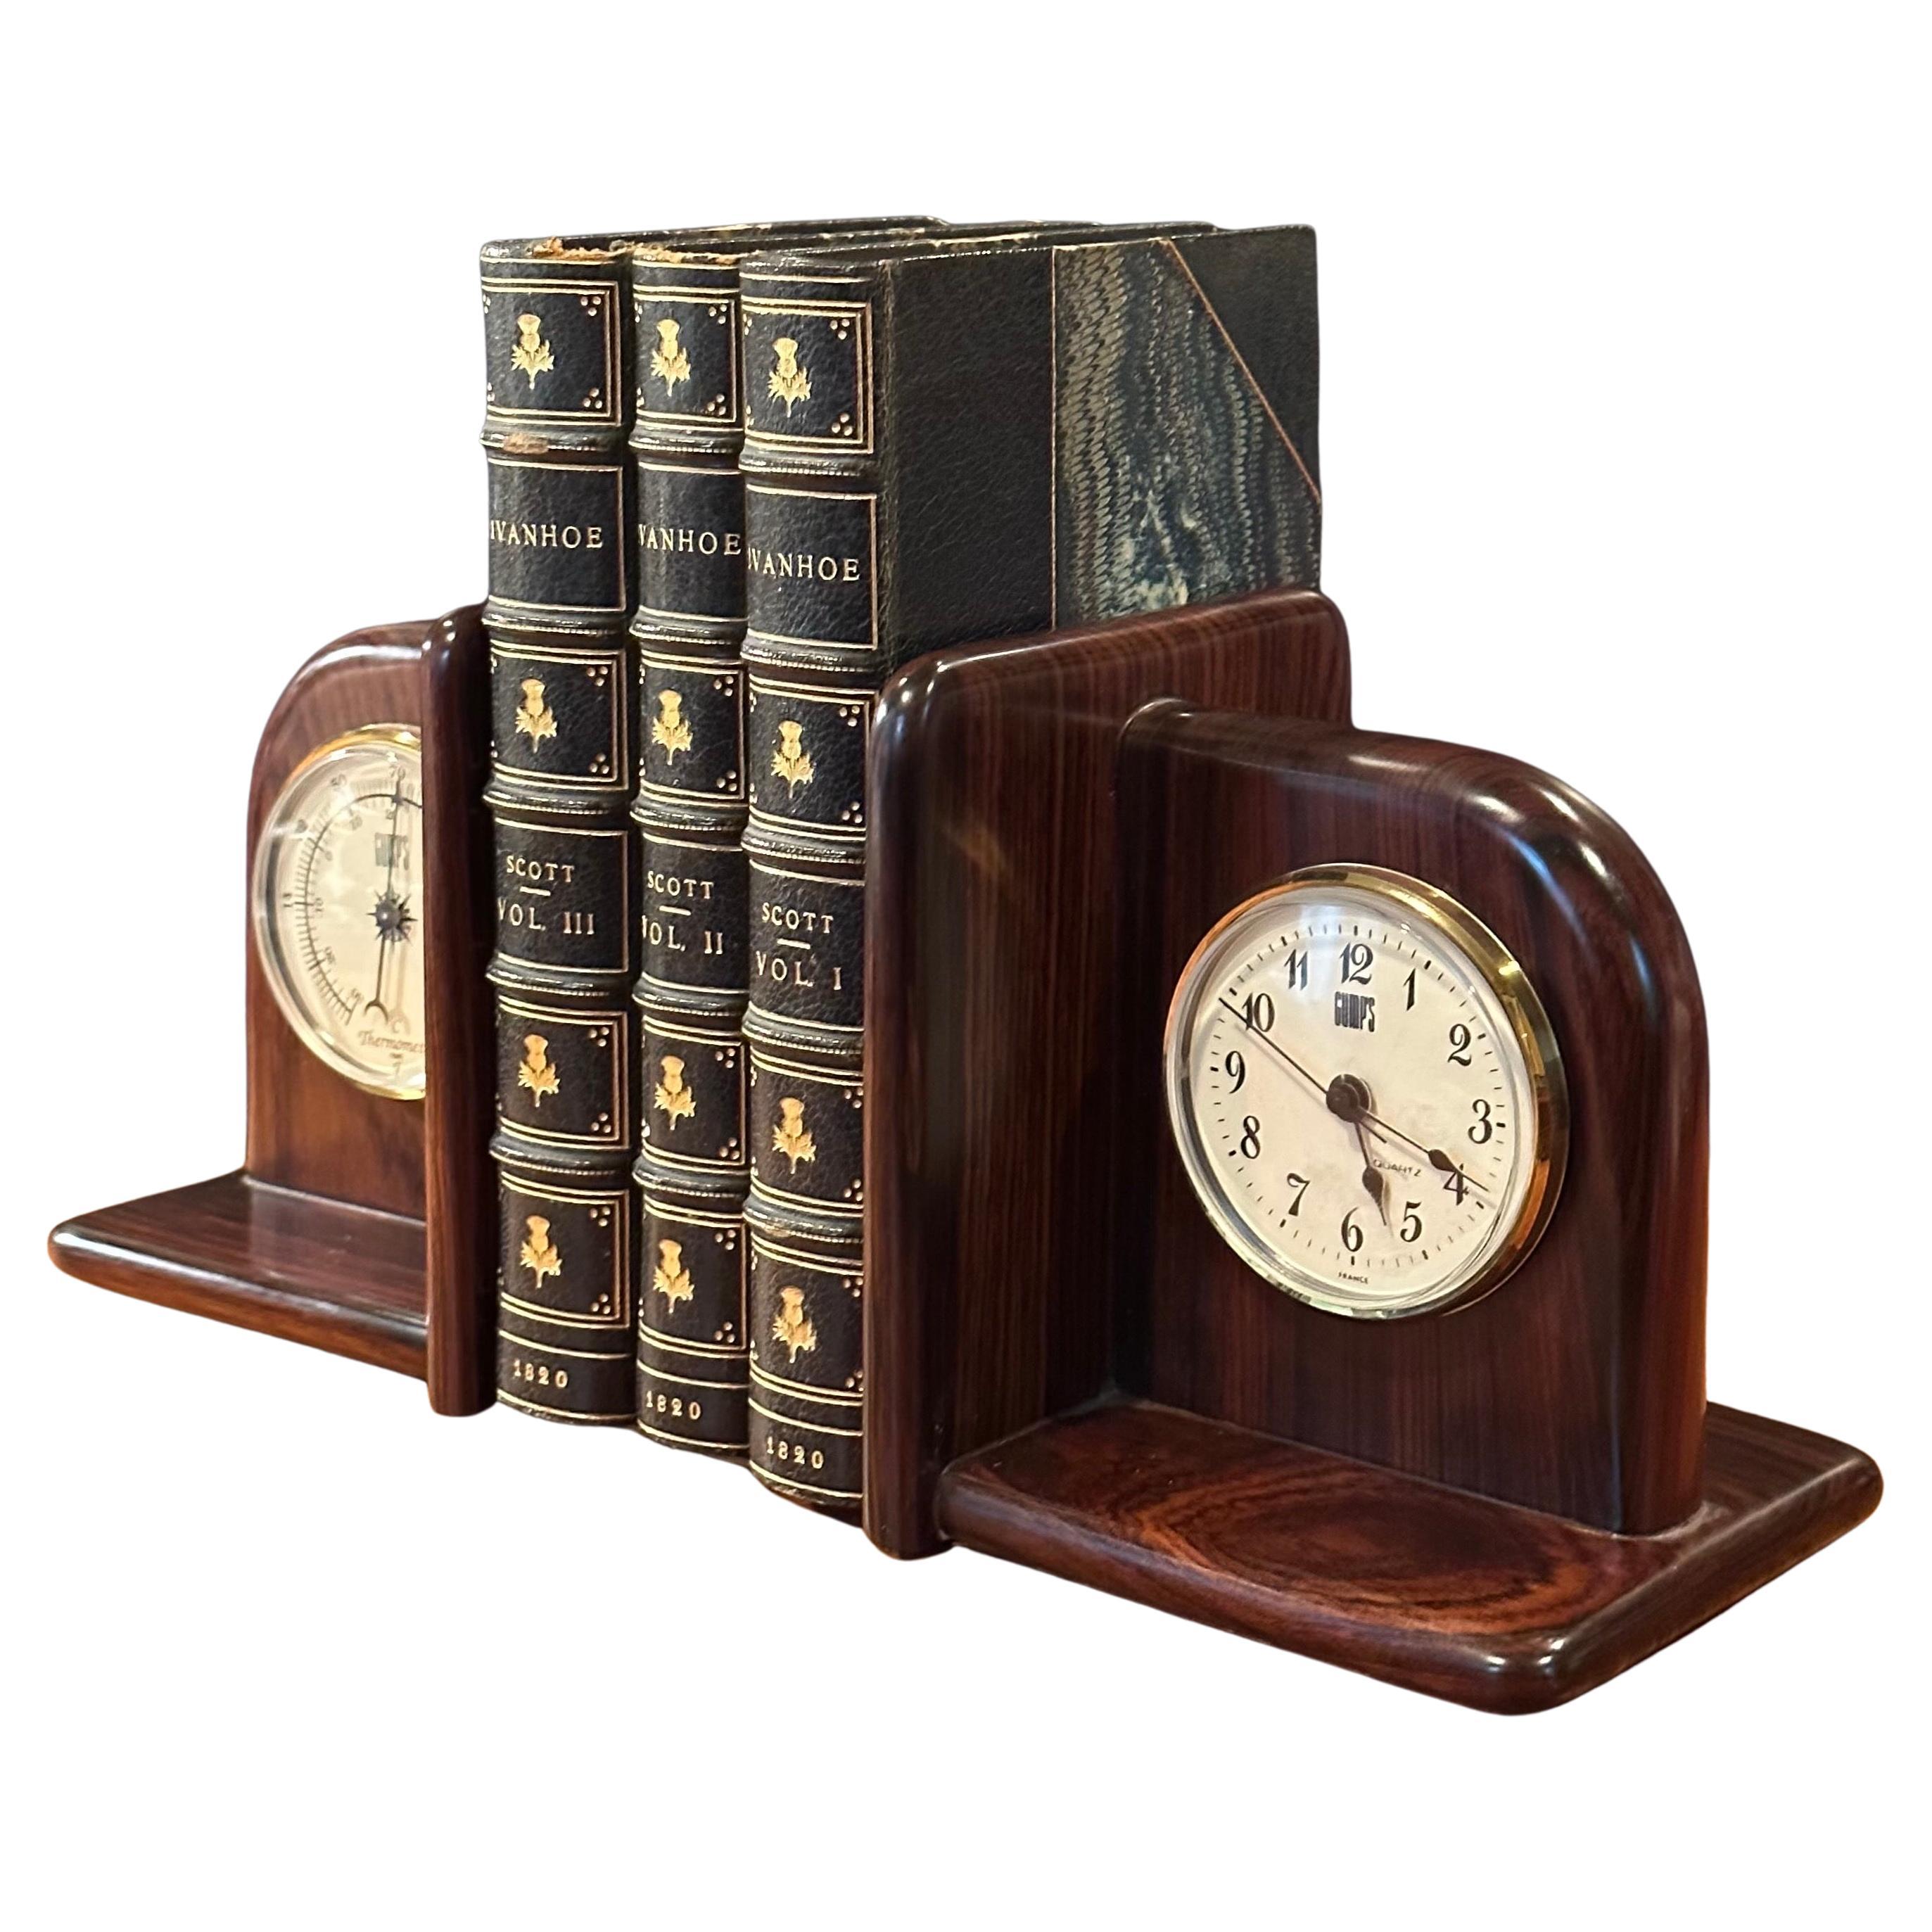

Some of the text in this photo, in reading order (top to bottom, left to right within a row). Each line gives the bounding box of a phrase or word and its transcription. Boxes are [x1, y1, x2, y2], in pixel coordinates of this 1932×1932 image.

[490, 519, 603, 549] IVANHOE
[638, 523, 742, 556] VANHOE
[506, 856, 575, 882] SCOTT
[647, 870, 714, 899] SCOTT
[497, 897, 595, 934] VOL. III
[762, 902, 834, 934] SCOTT
[704, 931, 723, 954] II
[756, 951, 841, 990] VOL. I
[1284, 948, 1310, 990] 11
[1340, 943, 1373, 984] 12
[1403, 968, 1416, 1010] 1
[1242, 992, 1275, 1032] 10
[1448, 1024, 1472, 1066] 2
[1226, 1050, 1246, 1093] 9
[1240, 1116, 1261, 1159] 8
[1468, 1099, 1492, 1144] 3
[1373, 1159, 1421, 1177] QUARTZ
[1444, 1163, 1469, 1205] 4
[1287, 1173, 1310, 1216] 7
[1342, 1207, 1364, 1252] 6
[1400, 1202, 1422, 1243] 5
[1338, 1271, 1368, 1284] FRANCE
[513, 1359, 568, 1388] 1820
[646, 1390, 701, 1420] 1820
[766, 1437, 824, 1469] 1820
